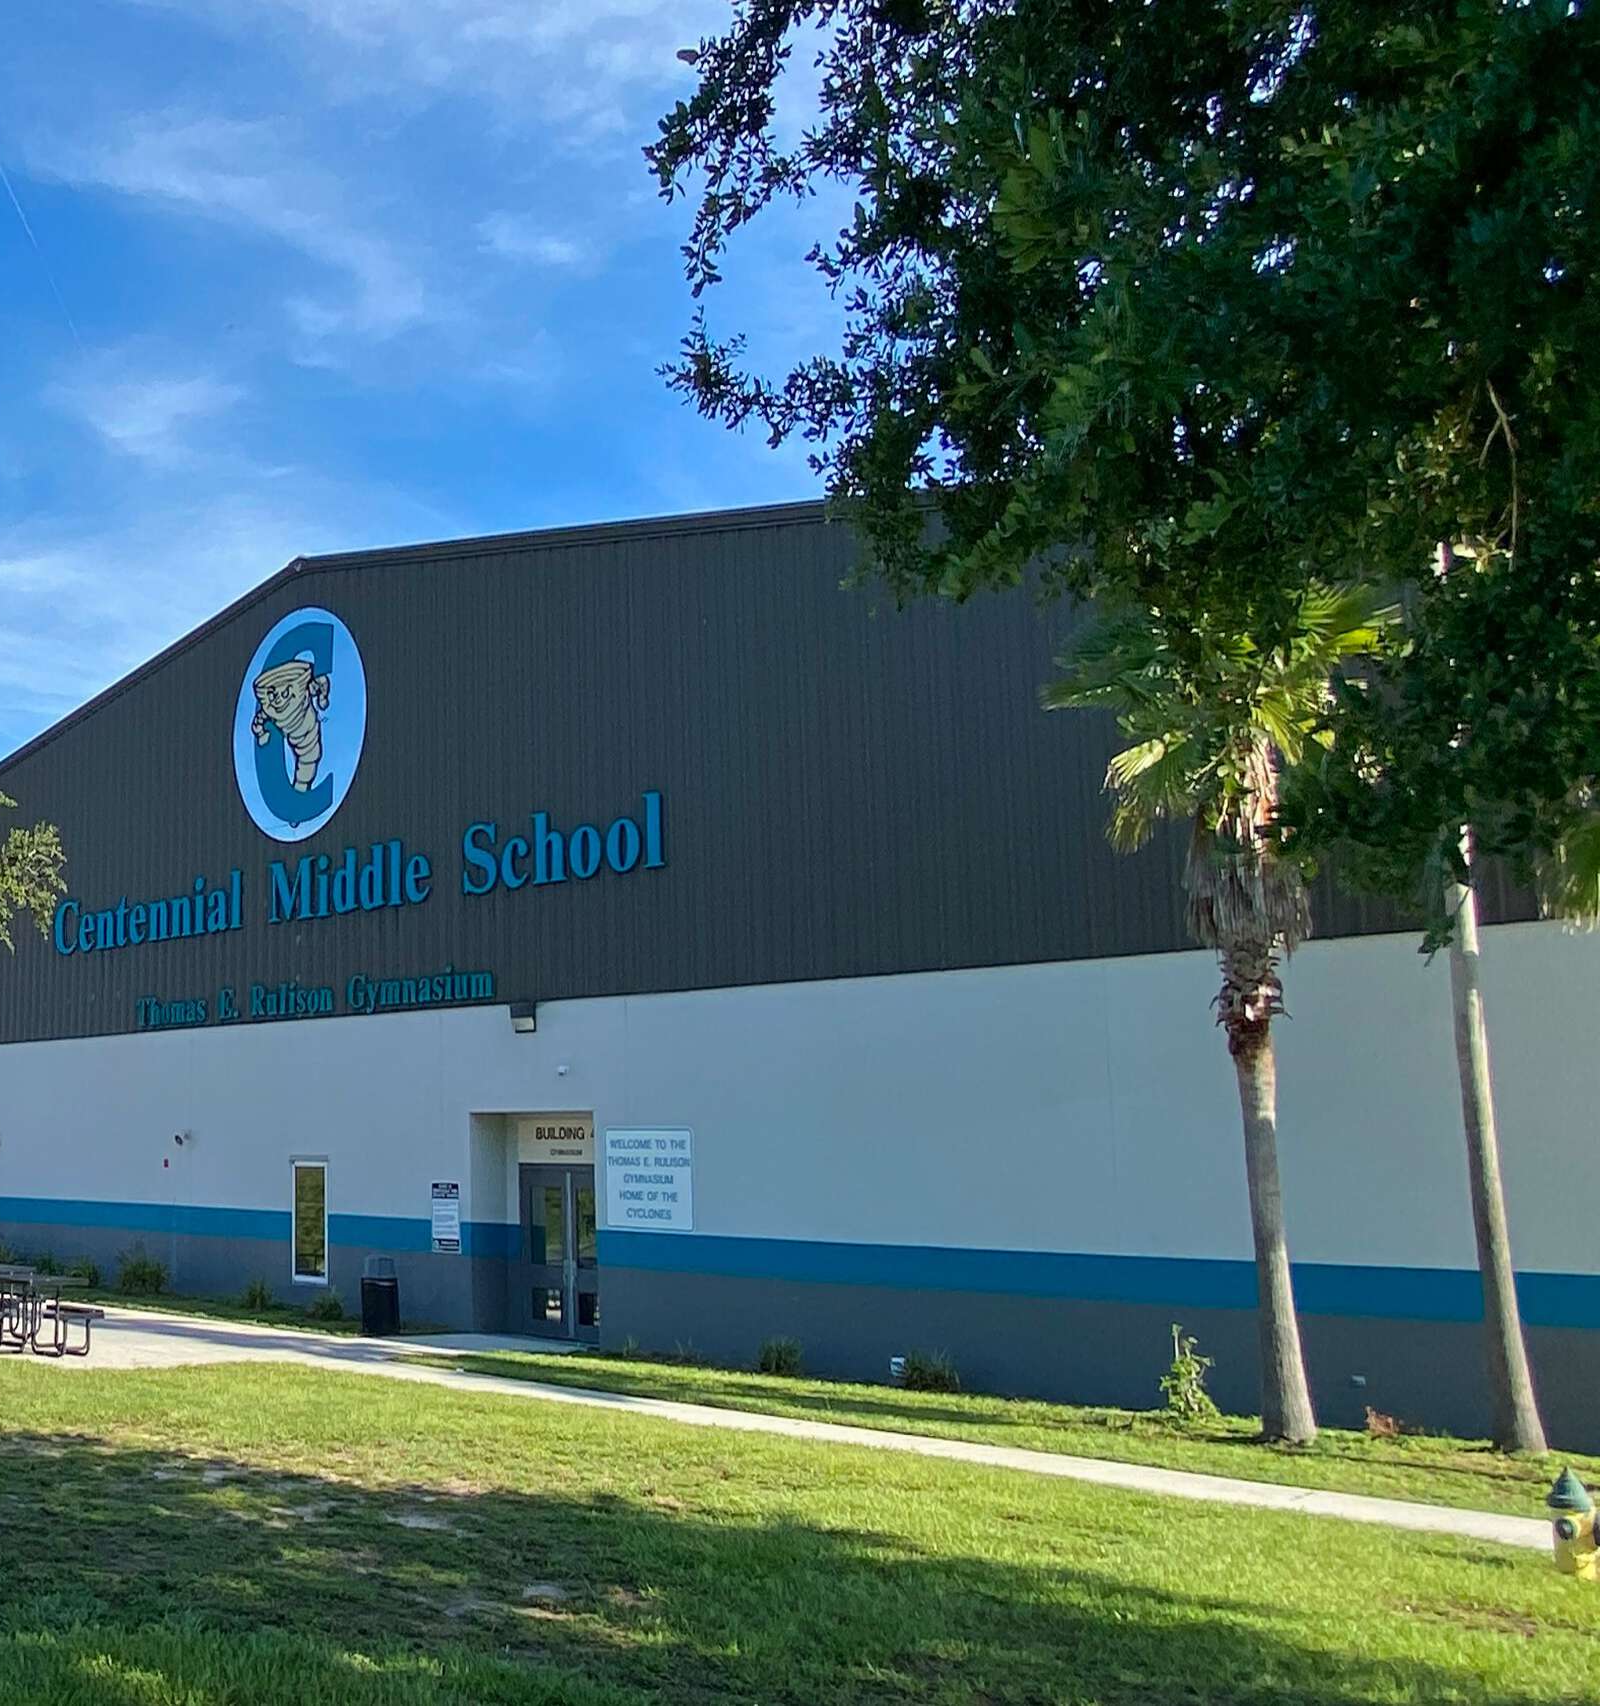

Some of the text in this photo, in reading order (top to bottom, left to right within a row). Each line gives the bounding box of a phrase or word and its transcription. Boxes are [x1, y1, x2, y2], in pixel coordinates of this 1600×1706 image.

[54, 790, 666, 956] Centennial Middle School
[136, 963, 495, 1027] Thomas E. Rulison Gymnasium
[535, 1126, 585, 1140] BUILDING
[609, 1138, 686, 1151] WELCOME TO THE
[608, 1155, 641, 1167] THOMAS
[654, 1156, 691, 1168] RULISON
[623, 1173, 674, 1185] GYMNASIUM
[619, 1190, 679, 1203] HOME OF THE
[626, 1207, 673, 1220] CYCLONES
